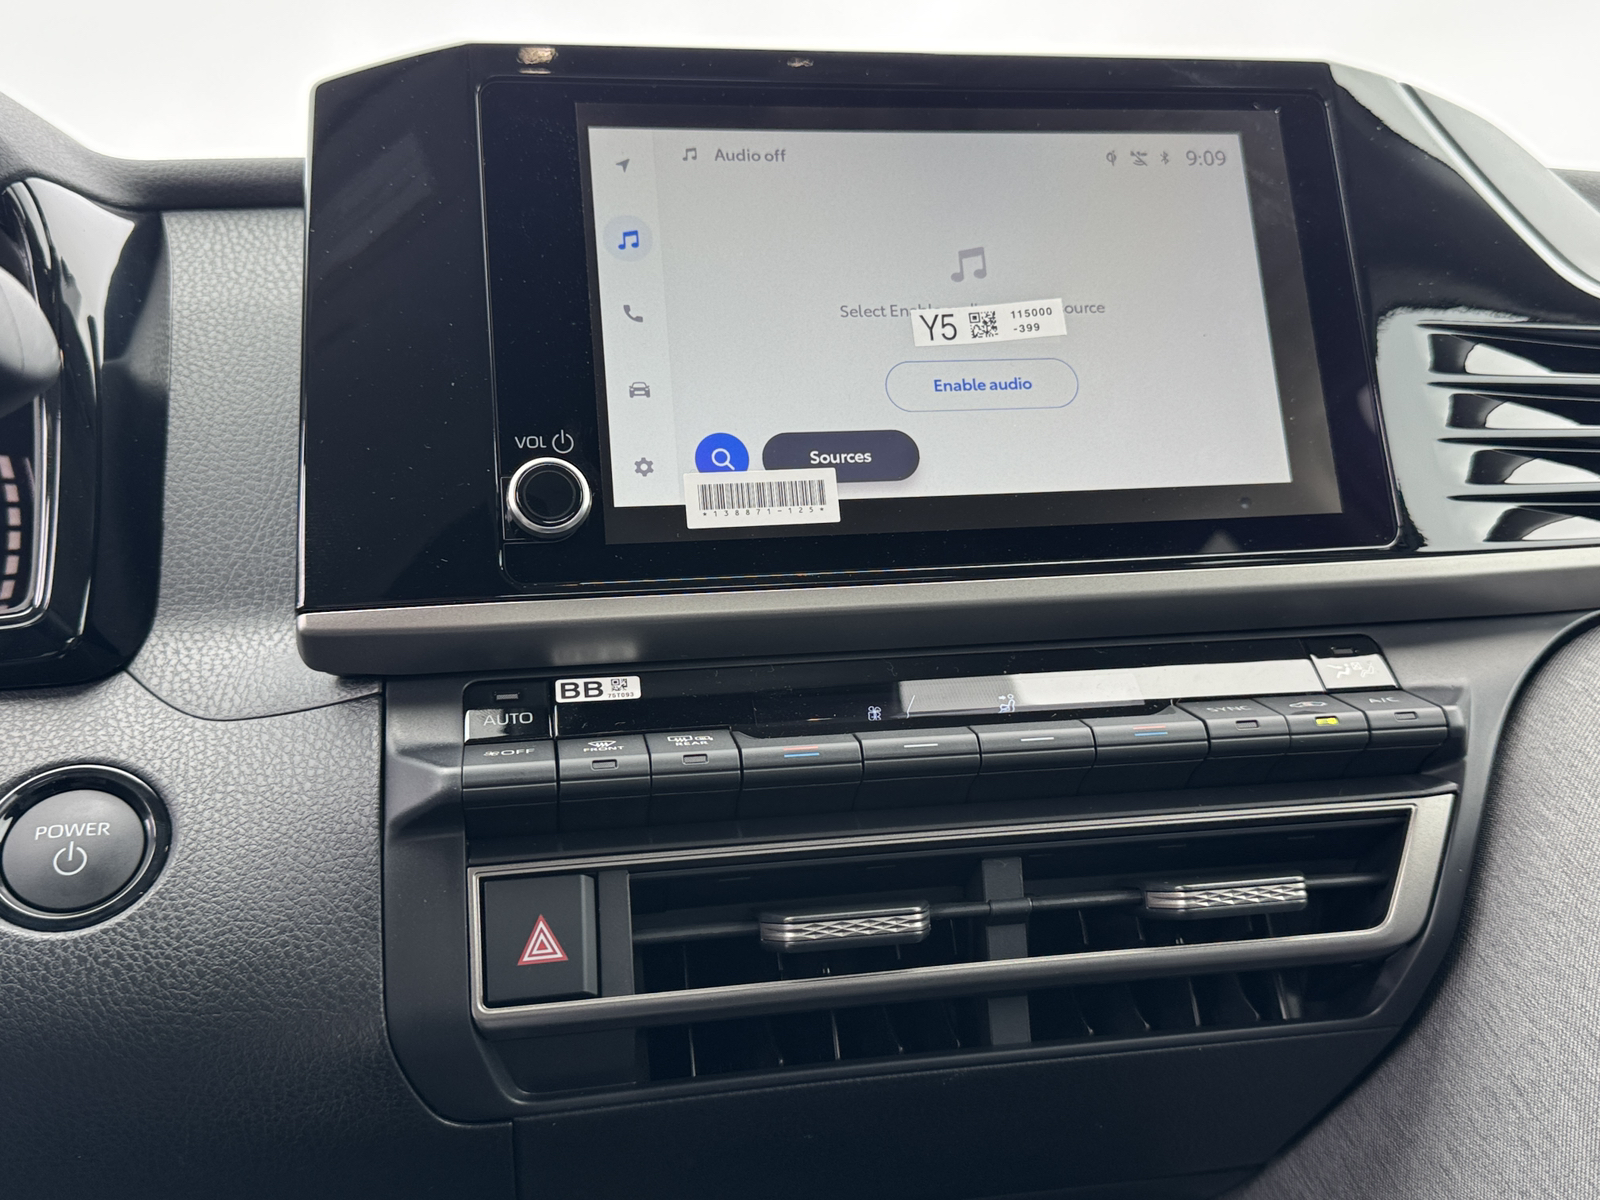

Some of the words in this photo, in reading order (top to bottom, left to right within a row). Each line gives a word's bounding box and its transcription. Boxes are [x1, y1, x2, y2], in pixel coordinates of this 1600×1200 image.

[714, 148, 762, 162] Audio
[764, 148, 787, 162] off
[1185, 150, 1227, 166] 9:09
[839, 303, 889, 318] Select
[1063, 303, 1106, 314] ource
[1010, 307, 1053, 319] 115000
[919, 313, 958, 341] Y5
[1013, 322, 1041, 333] -399
[933, 378, 987, 393] Enable
[989, 377, 1033, 391] audio
[514, 435, 547, 449] VOL
[809, 450, 872, 465] Sources
[560, 680, 604, 700] BB
[1368, 696, 1401, 704] A/C
[1206, 705, 1252, 713] SYNC
[483, 711, 534, 726] AUTO
[500, 747, 536, 756] OFF
[34, 822, 111, 841] POWER
